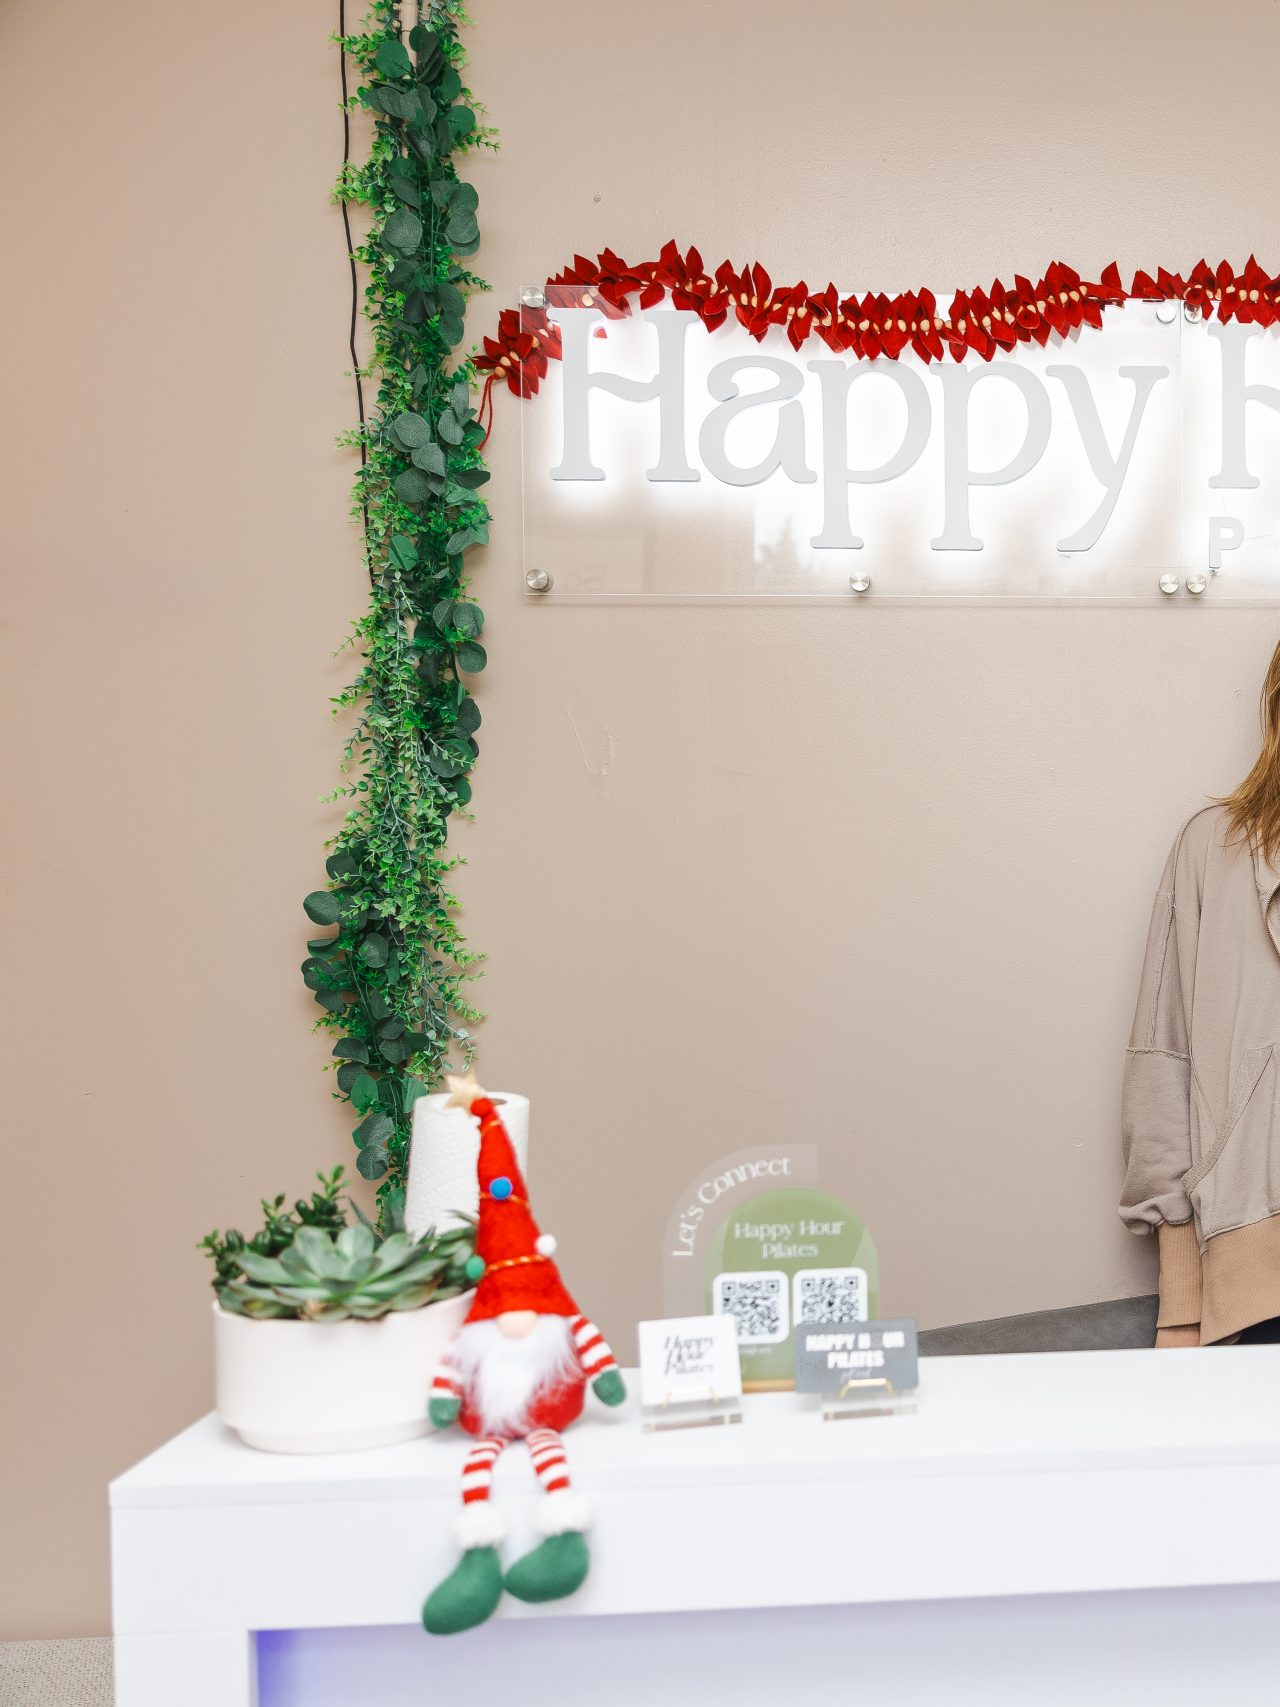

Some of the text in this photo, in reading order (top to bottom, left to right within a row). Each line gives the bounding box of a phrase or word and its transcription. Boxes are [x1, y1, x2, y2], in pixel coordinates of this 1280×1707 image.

[546, 308, 1169, 551] Happy
[672, 1157, 790, 1256] Let's Connect
[735, 1220, 845, 1241] Happy Hour
[762, 1241, 819, 1259] Pilates
